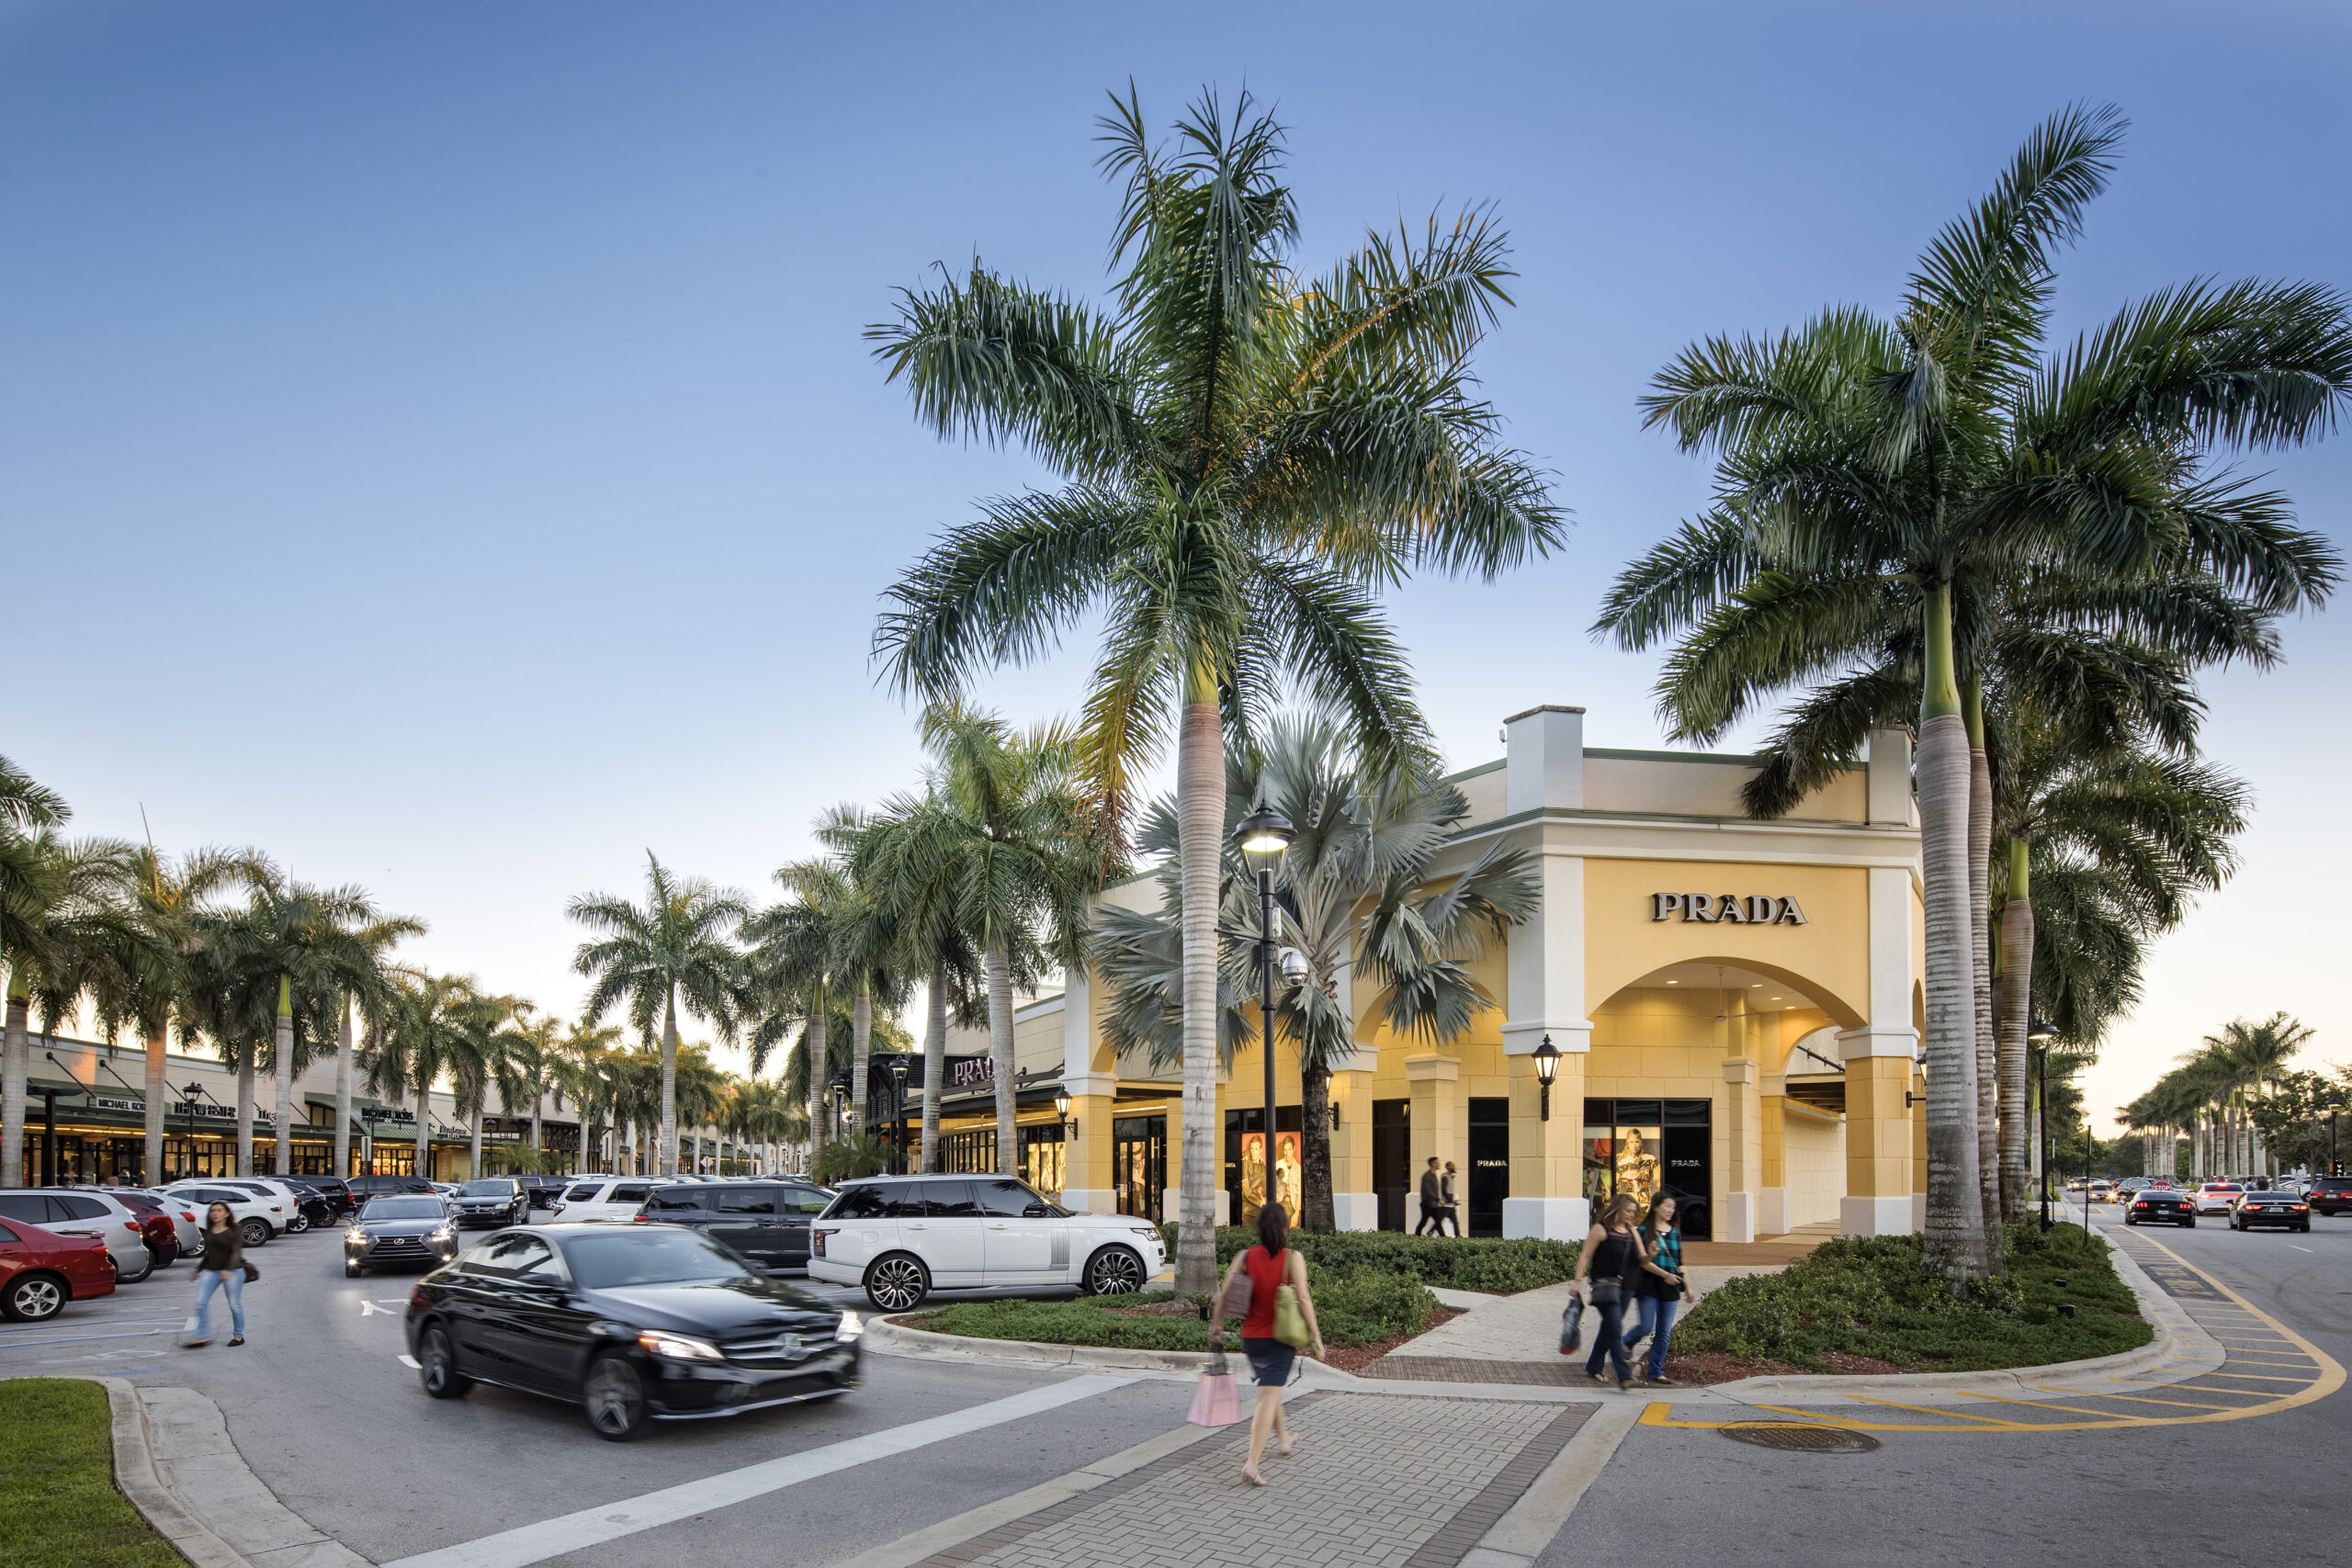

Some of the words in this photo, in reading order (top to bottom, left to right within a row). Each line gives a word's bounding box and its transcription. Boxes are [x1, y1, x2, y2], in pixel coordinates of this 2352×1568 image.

[1653, 892, 1808, 924] PRADA
[954, 1056, 995, 1085] PRAD
[97, 1098, 130, 1110] MICHAEL
[131, 1102, 146, 1111] KOR
